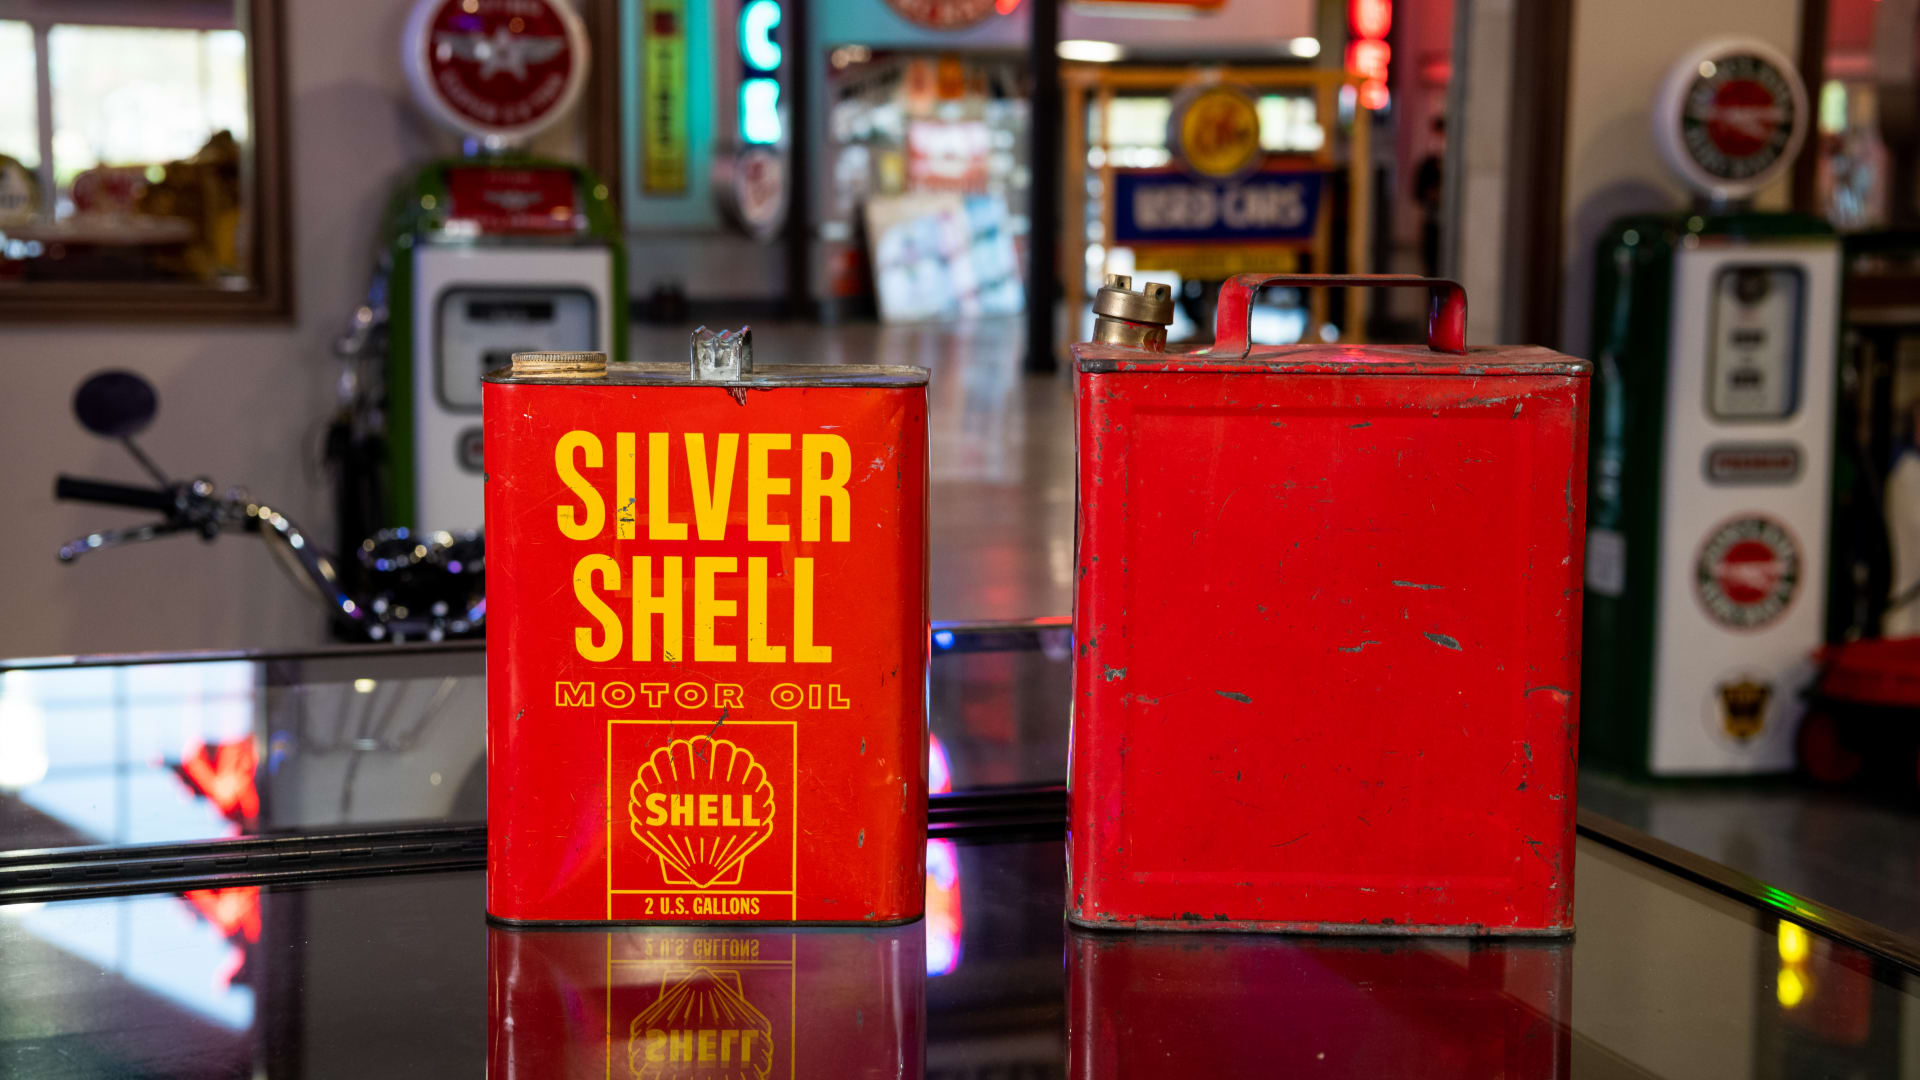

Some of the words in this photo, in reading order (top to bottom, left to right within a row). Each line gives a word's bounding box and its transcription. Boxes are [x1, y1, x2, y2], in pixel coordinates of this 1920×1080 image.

[555, 430, 852, 542] SILVER
[573, 554, 832, 663] SHELL
[555, 681, 744, 709] MOTOR
[770, 682, 850, 710] OIL
[645, 793, 760, 826] SHELL
[645, 898, 654, 915] 2
[660, 898, 689, 915] U.S.
[693, 898, 760, 915] GALLONS
